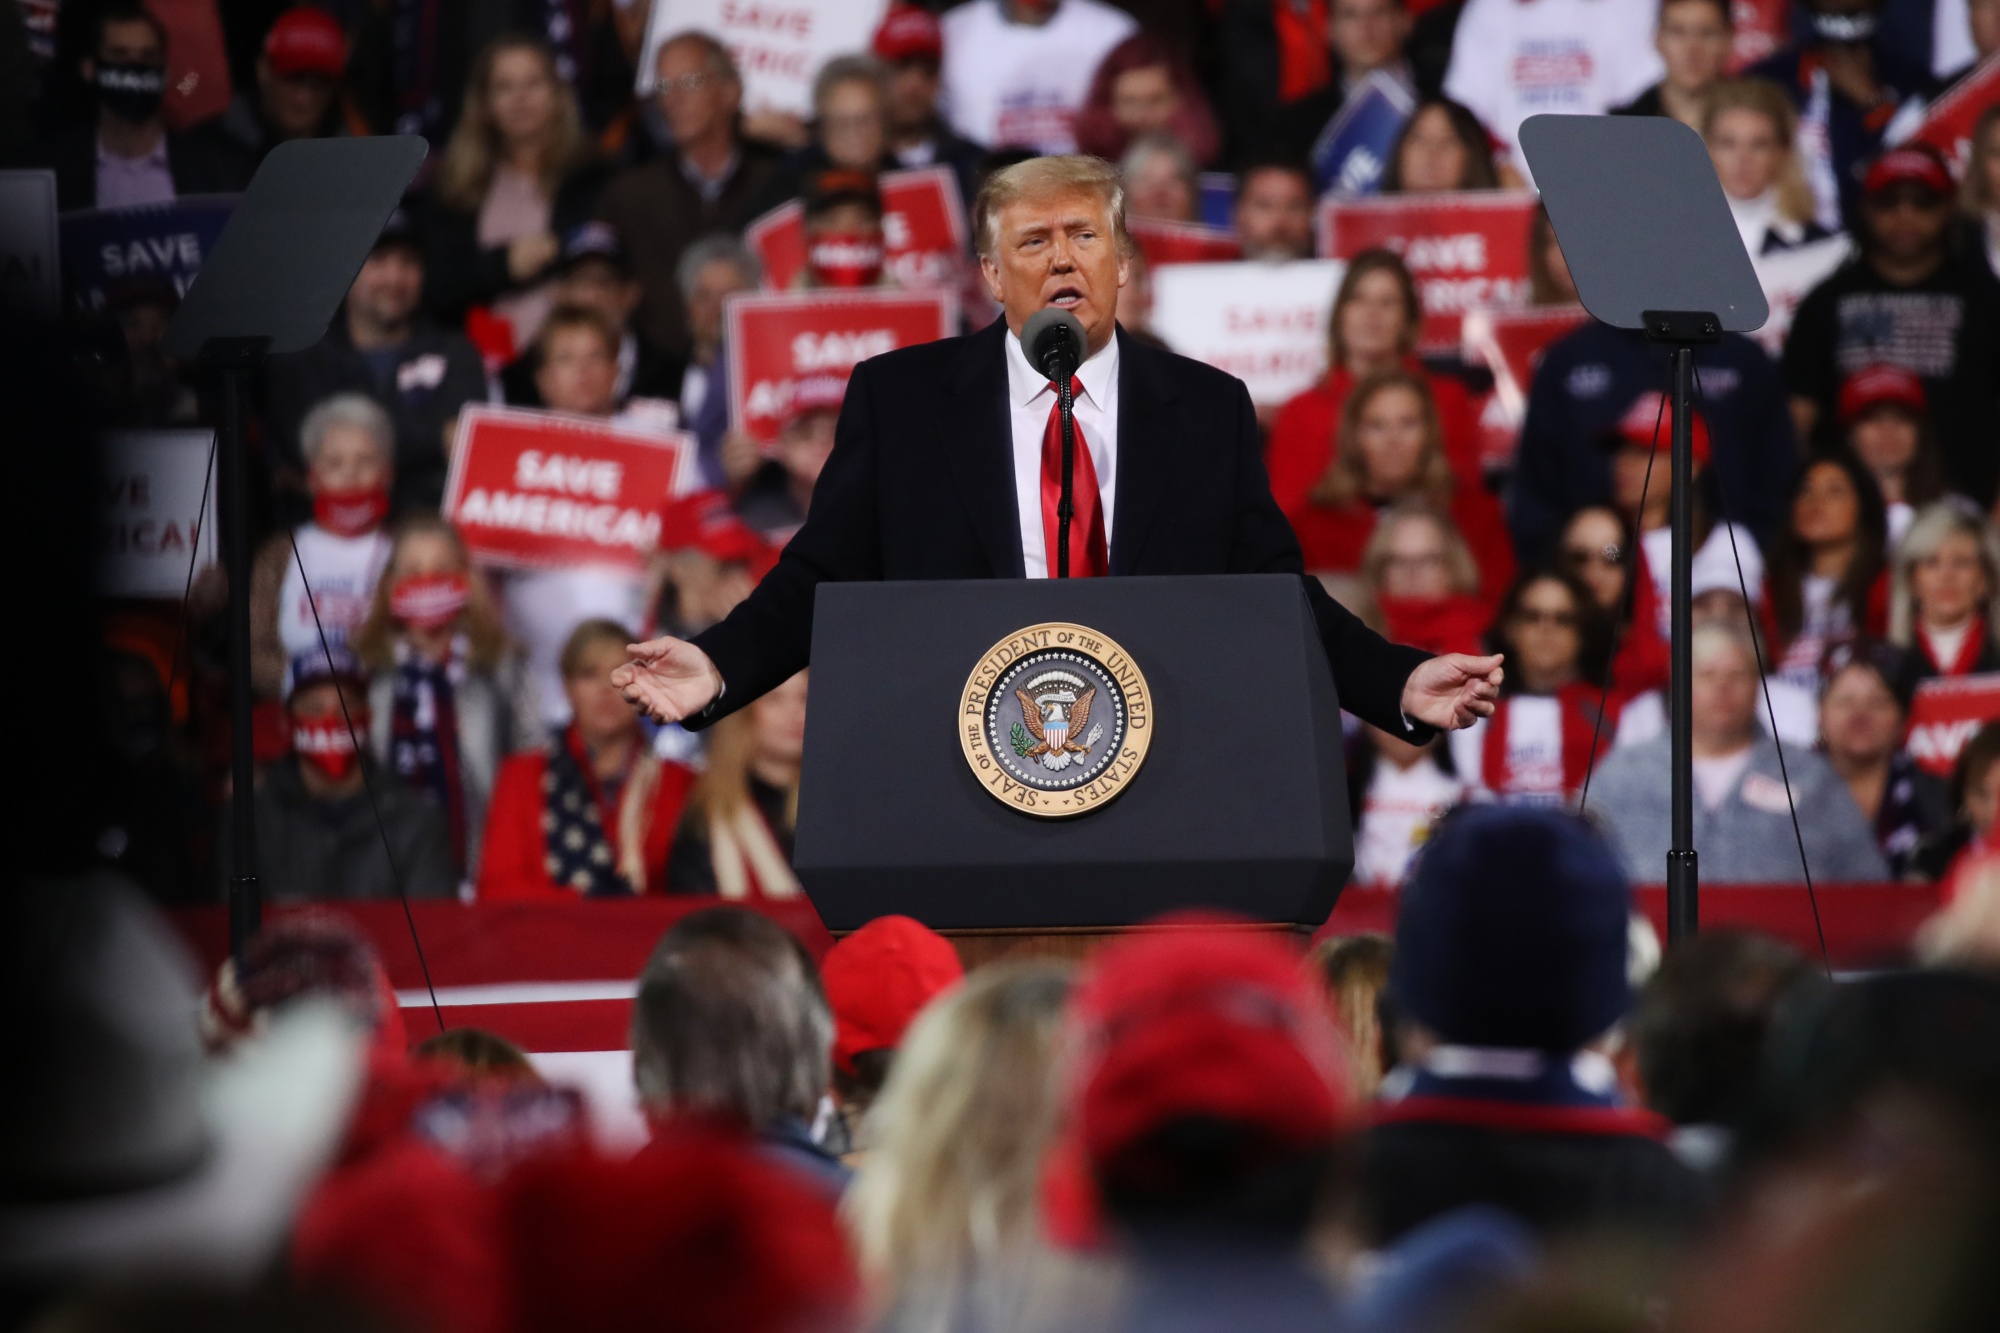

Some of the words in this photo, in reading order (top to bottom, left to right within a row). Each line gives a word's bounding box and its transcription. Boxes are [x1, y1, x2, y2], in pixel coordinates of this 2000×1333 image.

[101, 232, 201, 276] SAVE
[514, 449, 624, 500] SAVE
[459, 486, 663, 552] AMERICA!
[1057, 632, 1075, 644] OF
[1078, 635, 1103, 654] THE
[966, 630, 1051, 716] PRESIDENT
[1106, 651, 1146, 730] UNITED
[968, 723, 983, 752] THE
[975, 752, 991, 770] OF
[1073, 746, 1138, 807] STATES
[991, 771, 1039, 807] SEAL
